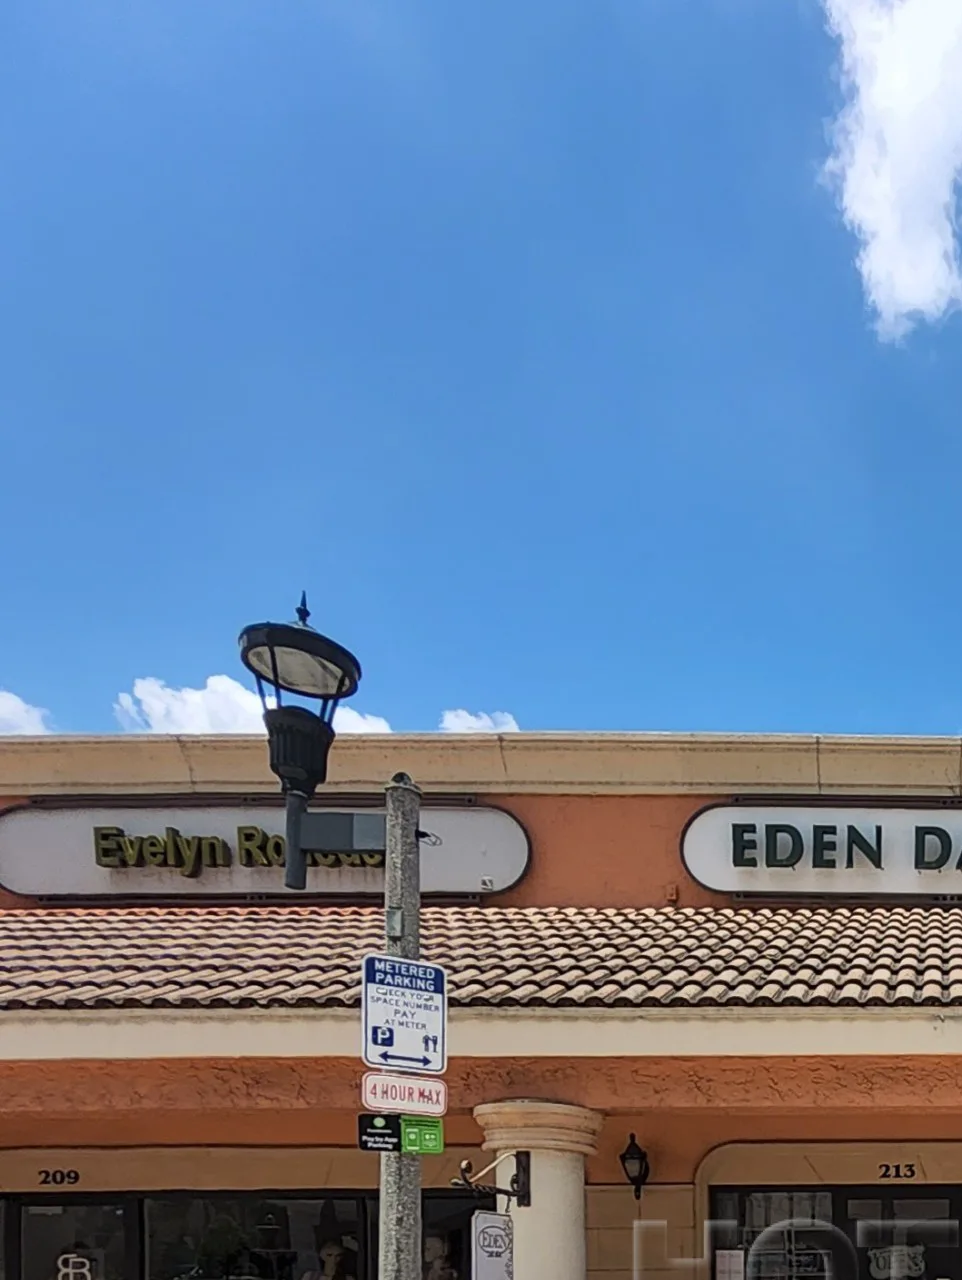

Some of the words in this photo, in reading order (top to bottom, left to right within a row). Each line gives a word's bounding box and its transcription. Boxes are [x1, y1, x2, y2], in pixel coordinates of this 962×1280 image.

[93, 826, 232, 877] Evelyn
[731, 823, 885, 870] EDEN
[374, 959, 435, 979] METERED
[375, 972, 435, 991] PARKING
[370, 995, 400, 1007] SPACE
[402, 1000, 440, 1012] NUMBER
[393, 1008, 416, 1019] PAY
[383, 1018, 396, 1026] AT
[397, 1019, 427, 1030] METER
[370, 1083, 377, 1099] 4
[381, 1083, 415, 1102] HOUR
[418, 1087, 442, 1106] MAX
[38, 1170, 80, 1185] 209
[878, 1163, 916, 1179] 213
